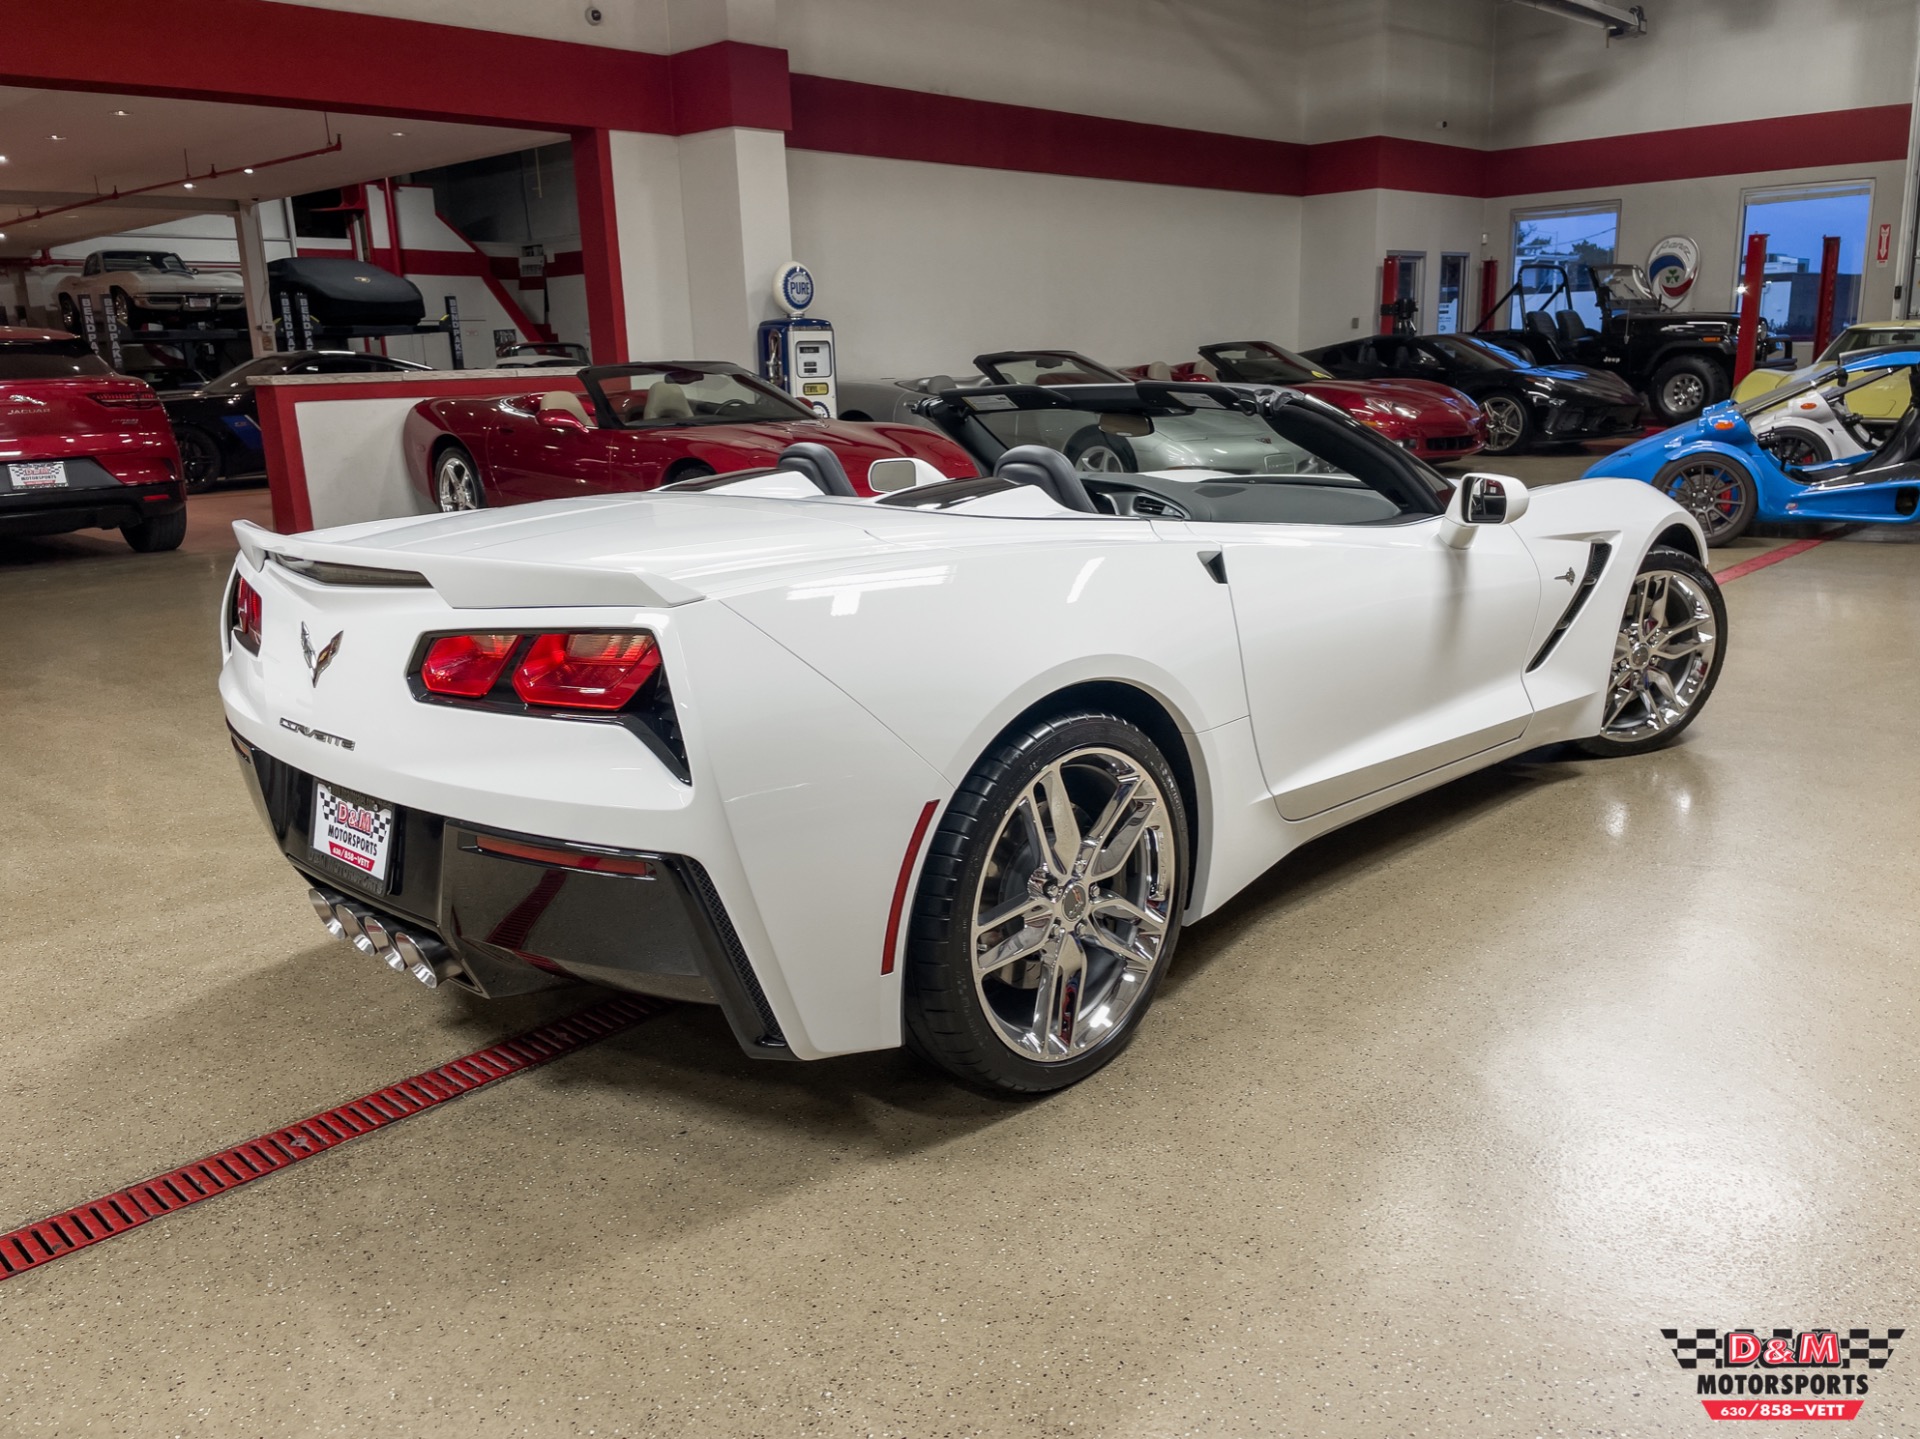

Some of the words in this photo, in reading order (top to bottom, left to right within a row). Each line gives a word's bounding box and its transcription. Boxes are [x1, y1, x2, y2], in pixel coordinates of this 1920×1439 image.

[790, 281, 810, 295] PURE
[103, 298, 122, 359] BENDPAK
[449, 299, 461, 351] BENDPAK
[1603, 356, 1620, 364] Jeep
[279, 717, 356, 752] CORVETTE
[338, 801, 373, 836] D&M
[328, 824, 378, 856] MOTORSPORTS
